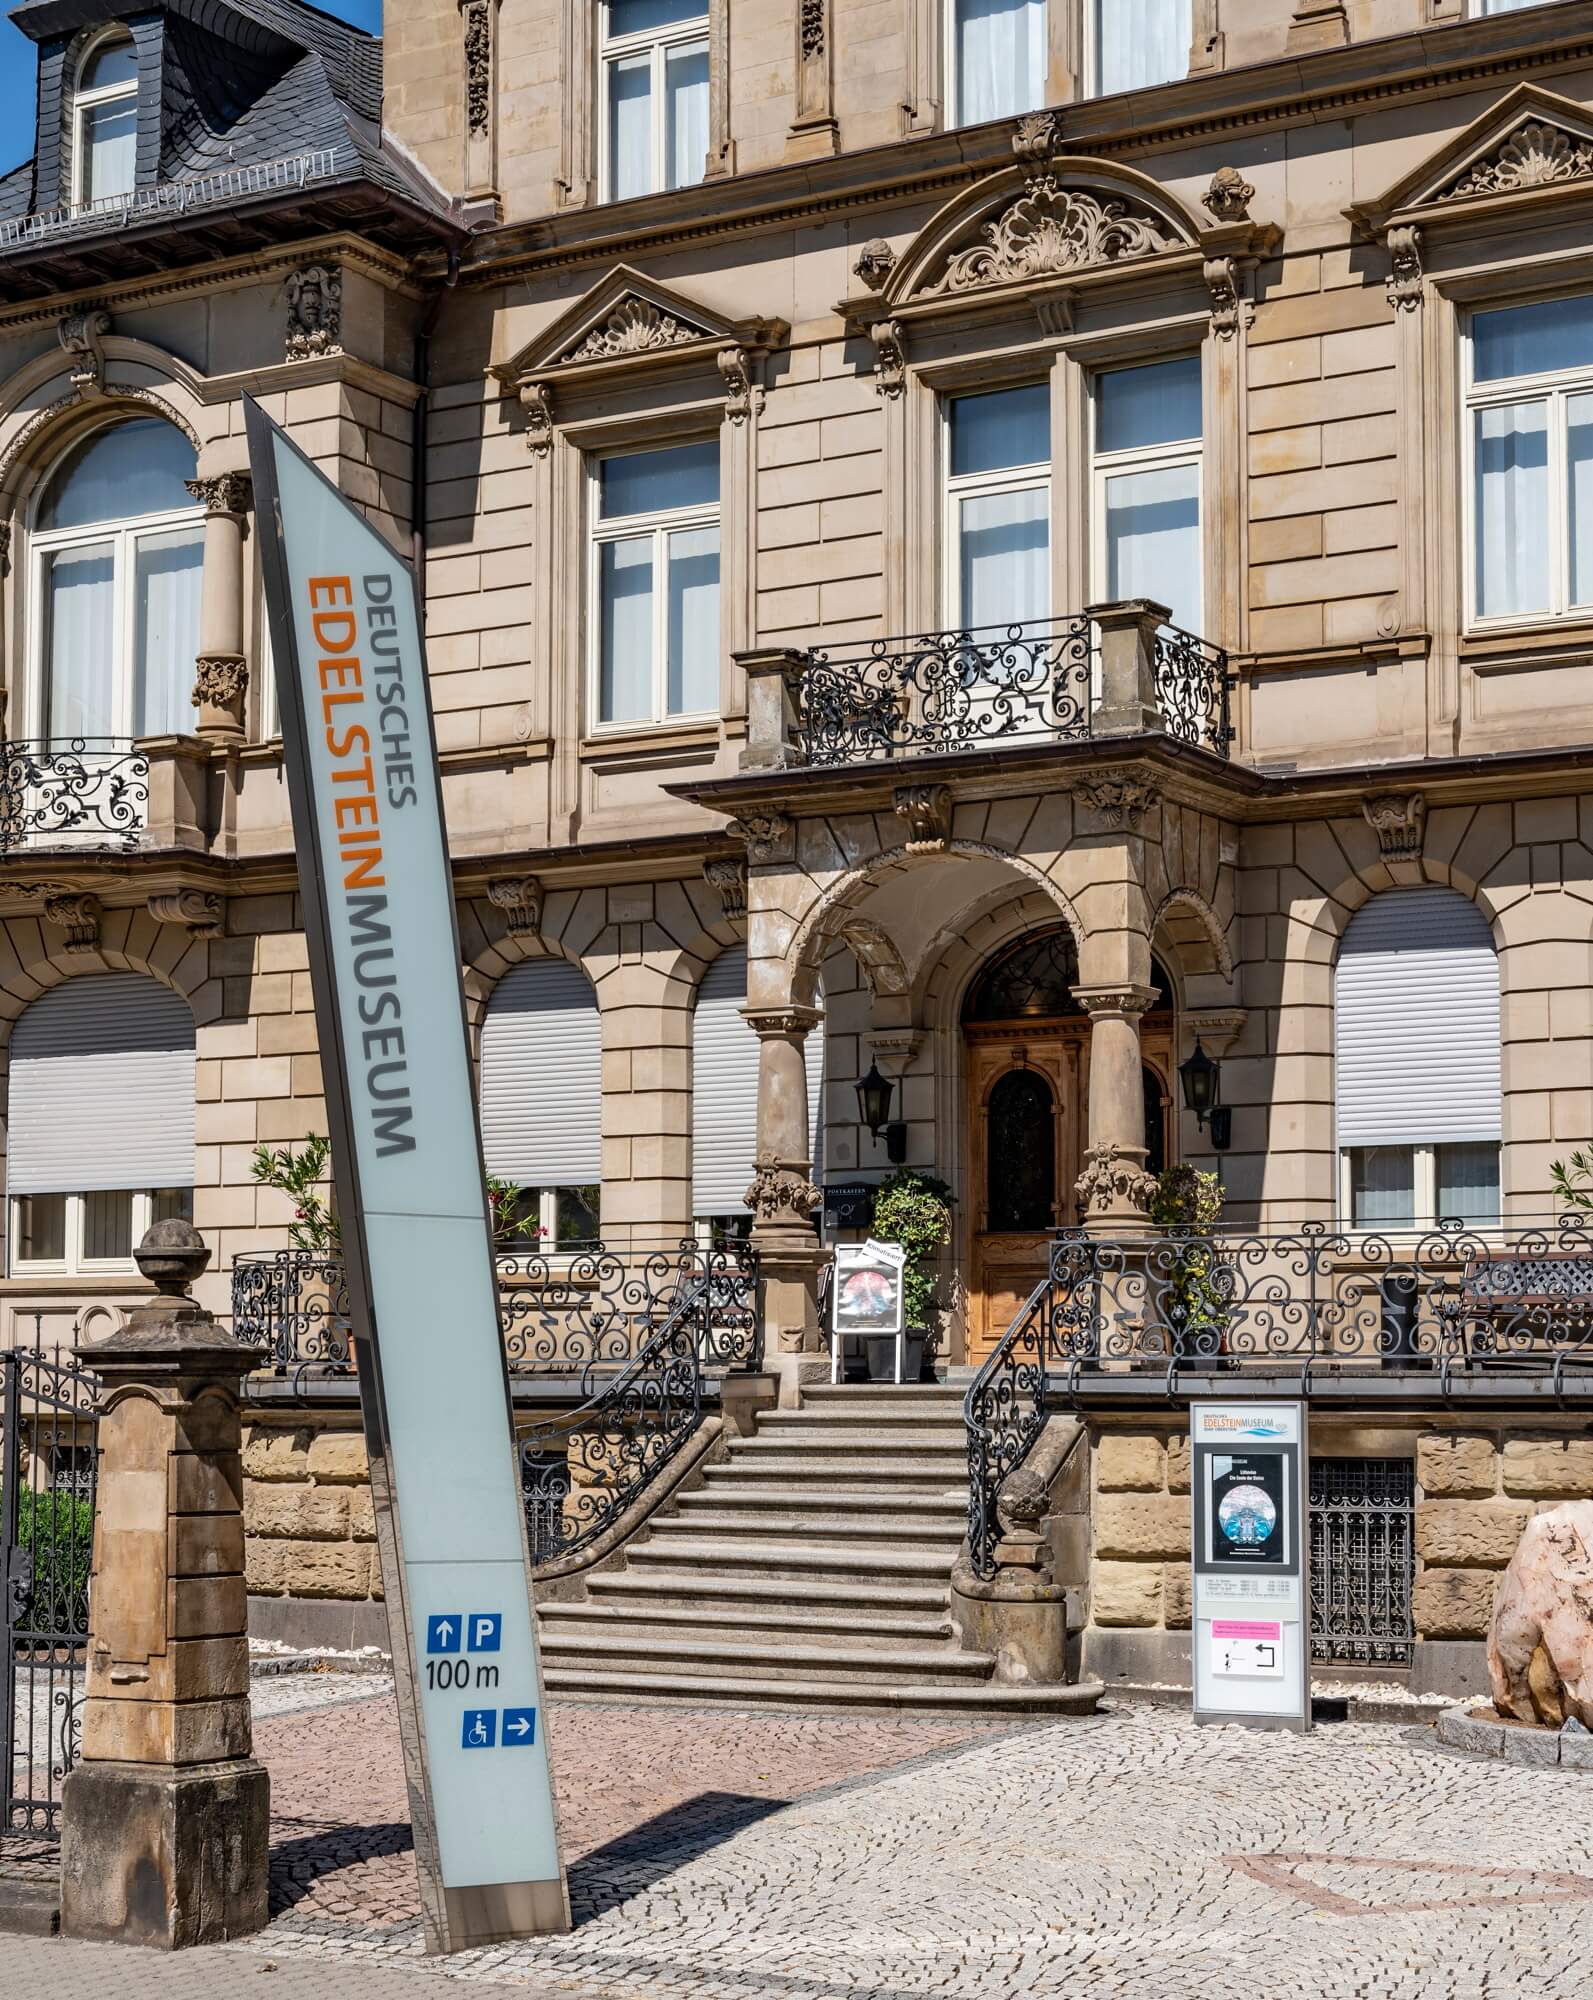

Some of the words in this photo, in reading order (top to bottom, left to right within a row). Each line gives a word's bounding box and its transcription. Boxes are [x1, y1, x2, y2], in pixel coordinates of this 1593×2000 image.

[362, 574, 417, 810] DEUTSCHES
[308, 575, 416, 1158] EDELSTEINMUSEUM
[1203, 1418, 1274, 1427] EDELSTEINMUSEUM
[476, 1619, 494, 1647] P
[426, 1659, 470, 1690] 100
[476, 1665, 500, 1688] m
